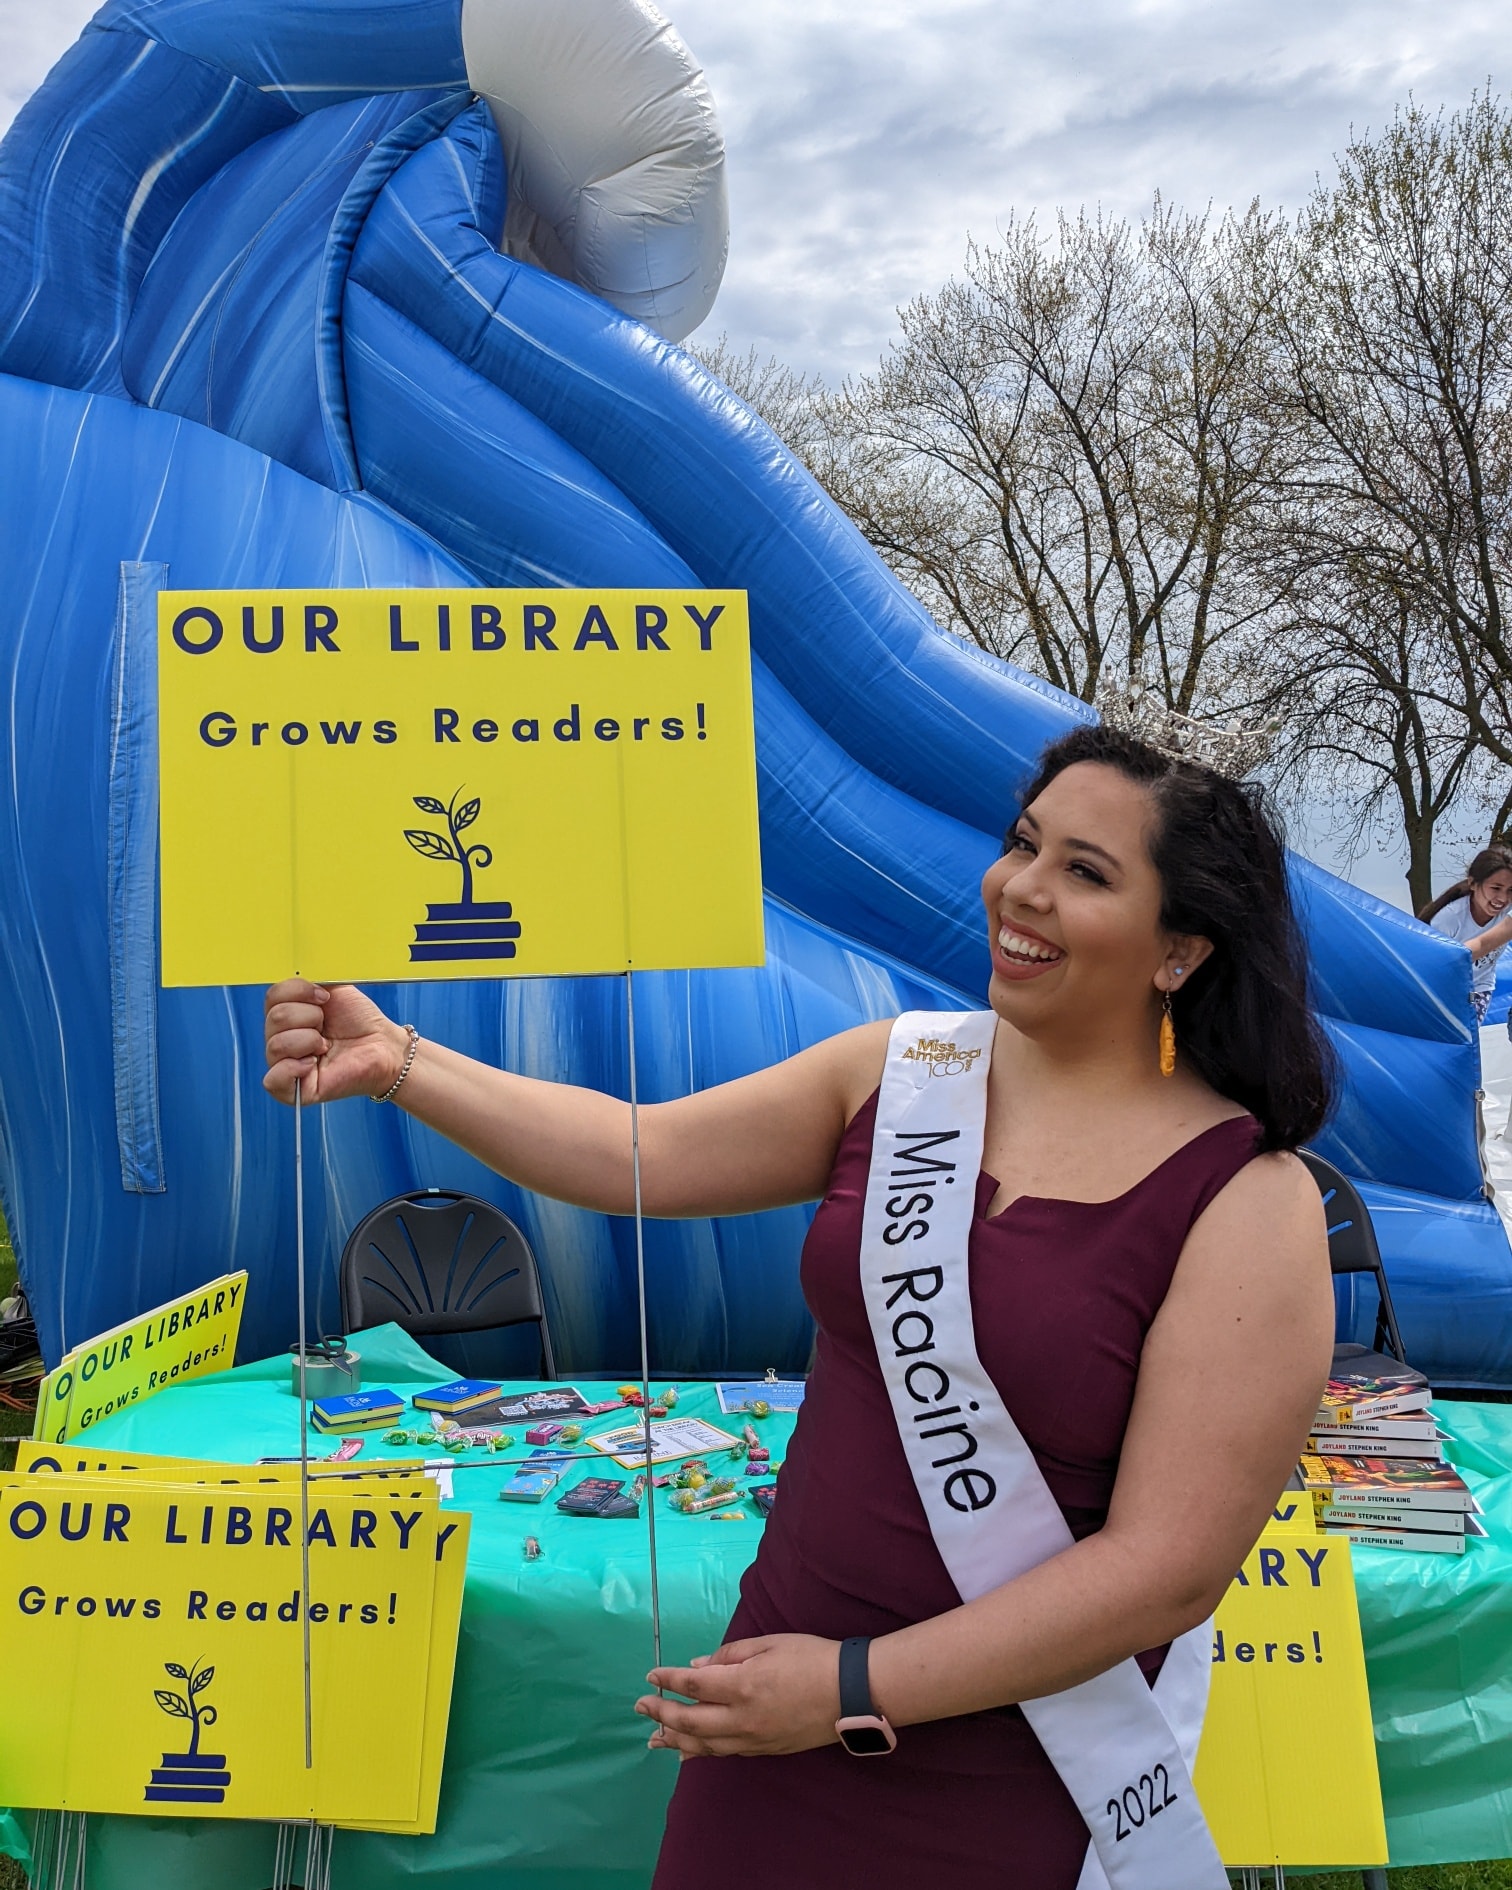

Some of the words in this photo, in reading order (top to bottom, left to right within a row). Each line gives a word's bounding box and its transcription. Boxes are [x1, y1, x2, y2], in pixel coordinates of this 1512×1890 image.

[173, 606, 340, 654] OUR
[390, 605, 725, 651] LIBRARY
[200, 712, 397, 747] Grows
[435, 703, 706, 742] Readers!
[903, 1047, 982, 1062] America
[918, 1039, 956, 1052] Miss
[927, 1060, 964, 1078] 100
[882, 1129, 961, 1246] Miss
[81, 1334, 134, 1382] OUR
[144, 1283, 242, 1350] LIBRARY
[80, 1386, 140, 1429] Grows
[148, 1333, 227, 1390] Readers!
[881, 1264, 997, 1513] Racine
[1355, 1408, 1372, 1416] JOYLAND
[1373, 1404, 1388, 1413] STEPHEN
[1366, 1424, 1380, 1432] KING
[1338, 1494, 1366, 1502] JOYLAND
[1358, 1512, 1386, 1520] STEPHEN
[1386, 1514, 1402, 1522] KING
[10, 1501, 131, 1541] OUR
[165, 1505, 423, 1549] LIBRARY
[1389, 1538, 1404, 1546] KING
[18, 1585, 161, 1619] Grows
[187, 1590, 397, 1624] Readers!
[1107, 1763, 1178, 1841] 2022
